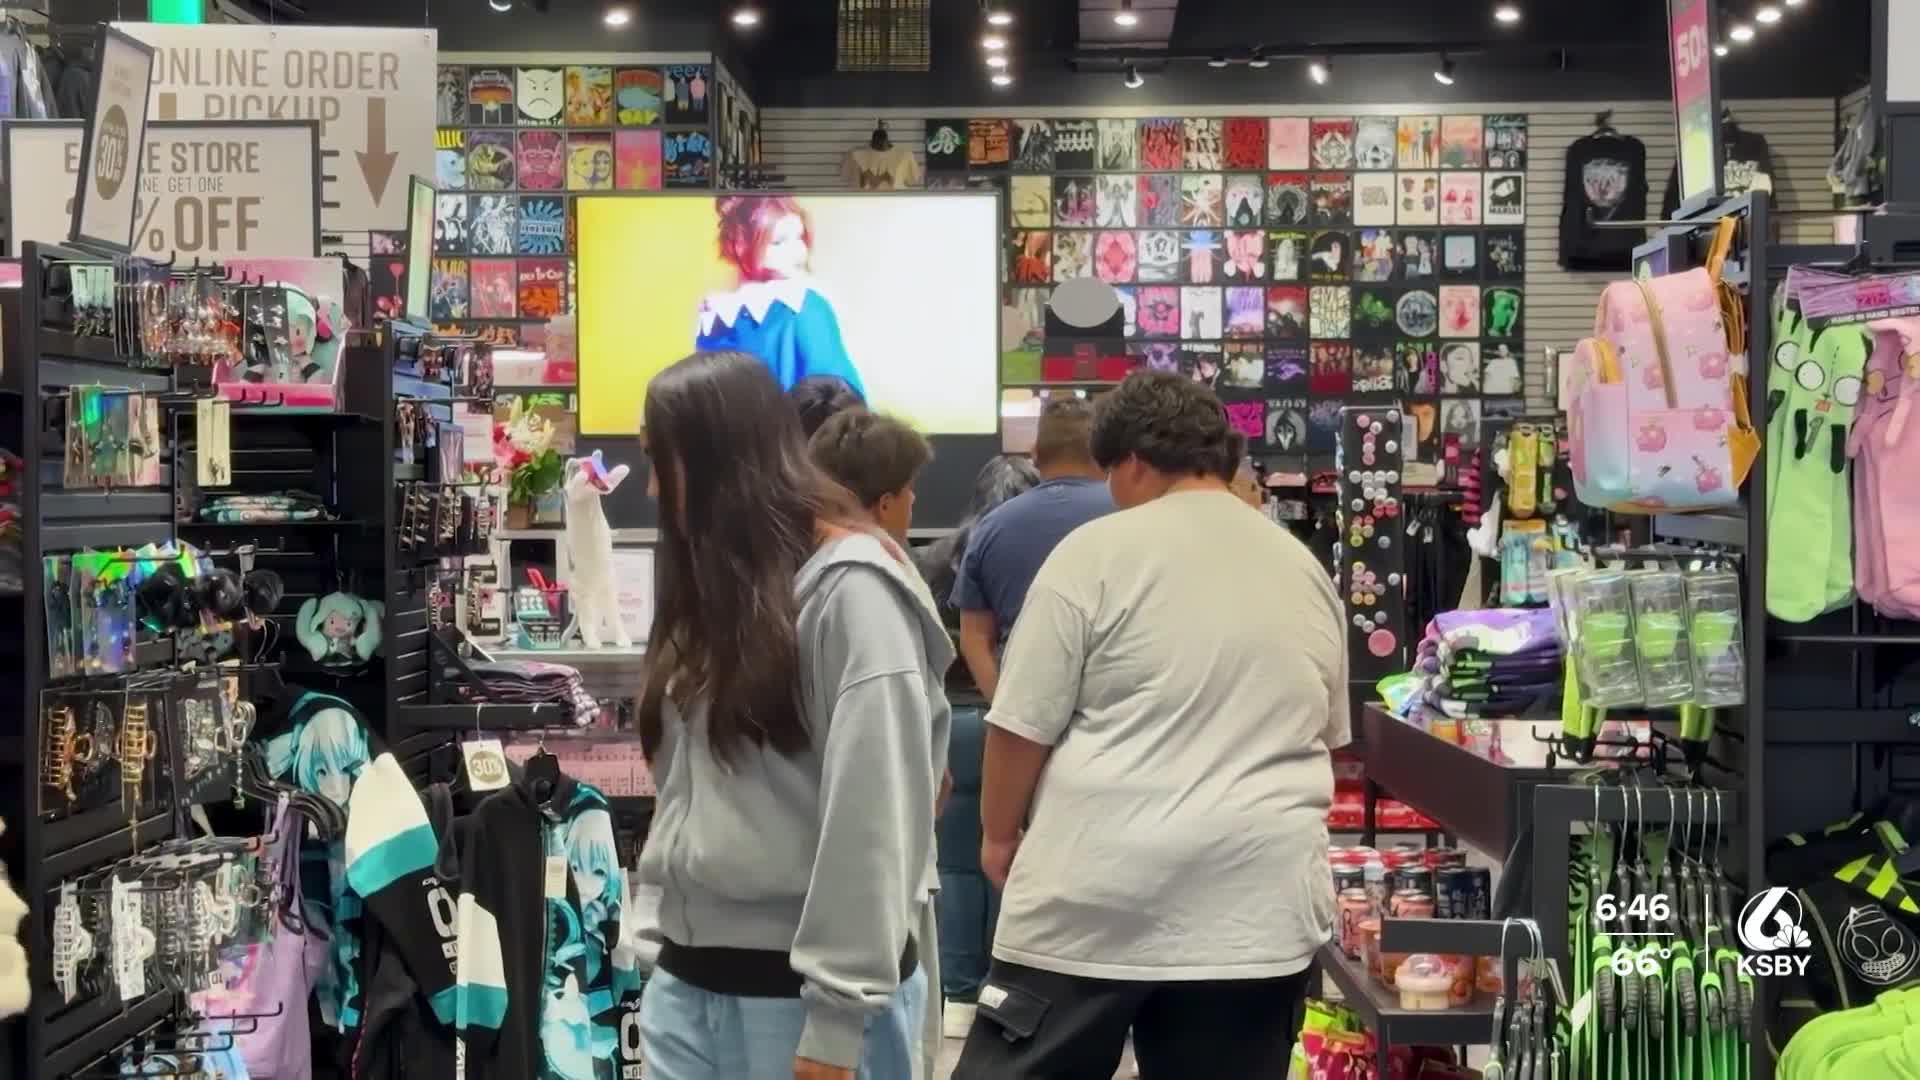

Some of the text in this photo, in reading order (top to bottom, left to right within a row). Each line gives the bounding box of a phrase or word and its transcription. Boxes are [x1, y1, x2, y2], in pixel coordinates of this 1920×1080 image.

[284, 50, 399, 90] ORDER
[171, 141, 260, 174] STORE
[167, 177, 192, 193] GET
[198, 177, 224, 193] ONE
[174, 196, 261, 252] OFF
